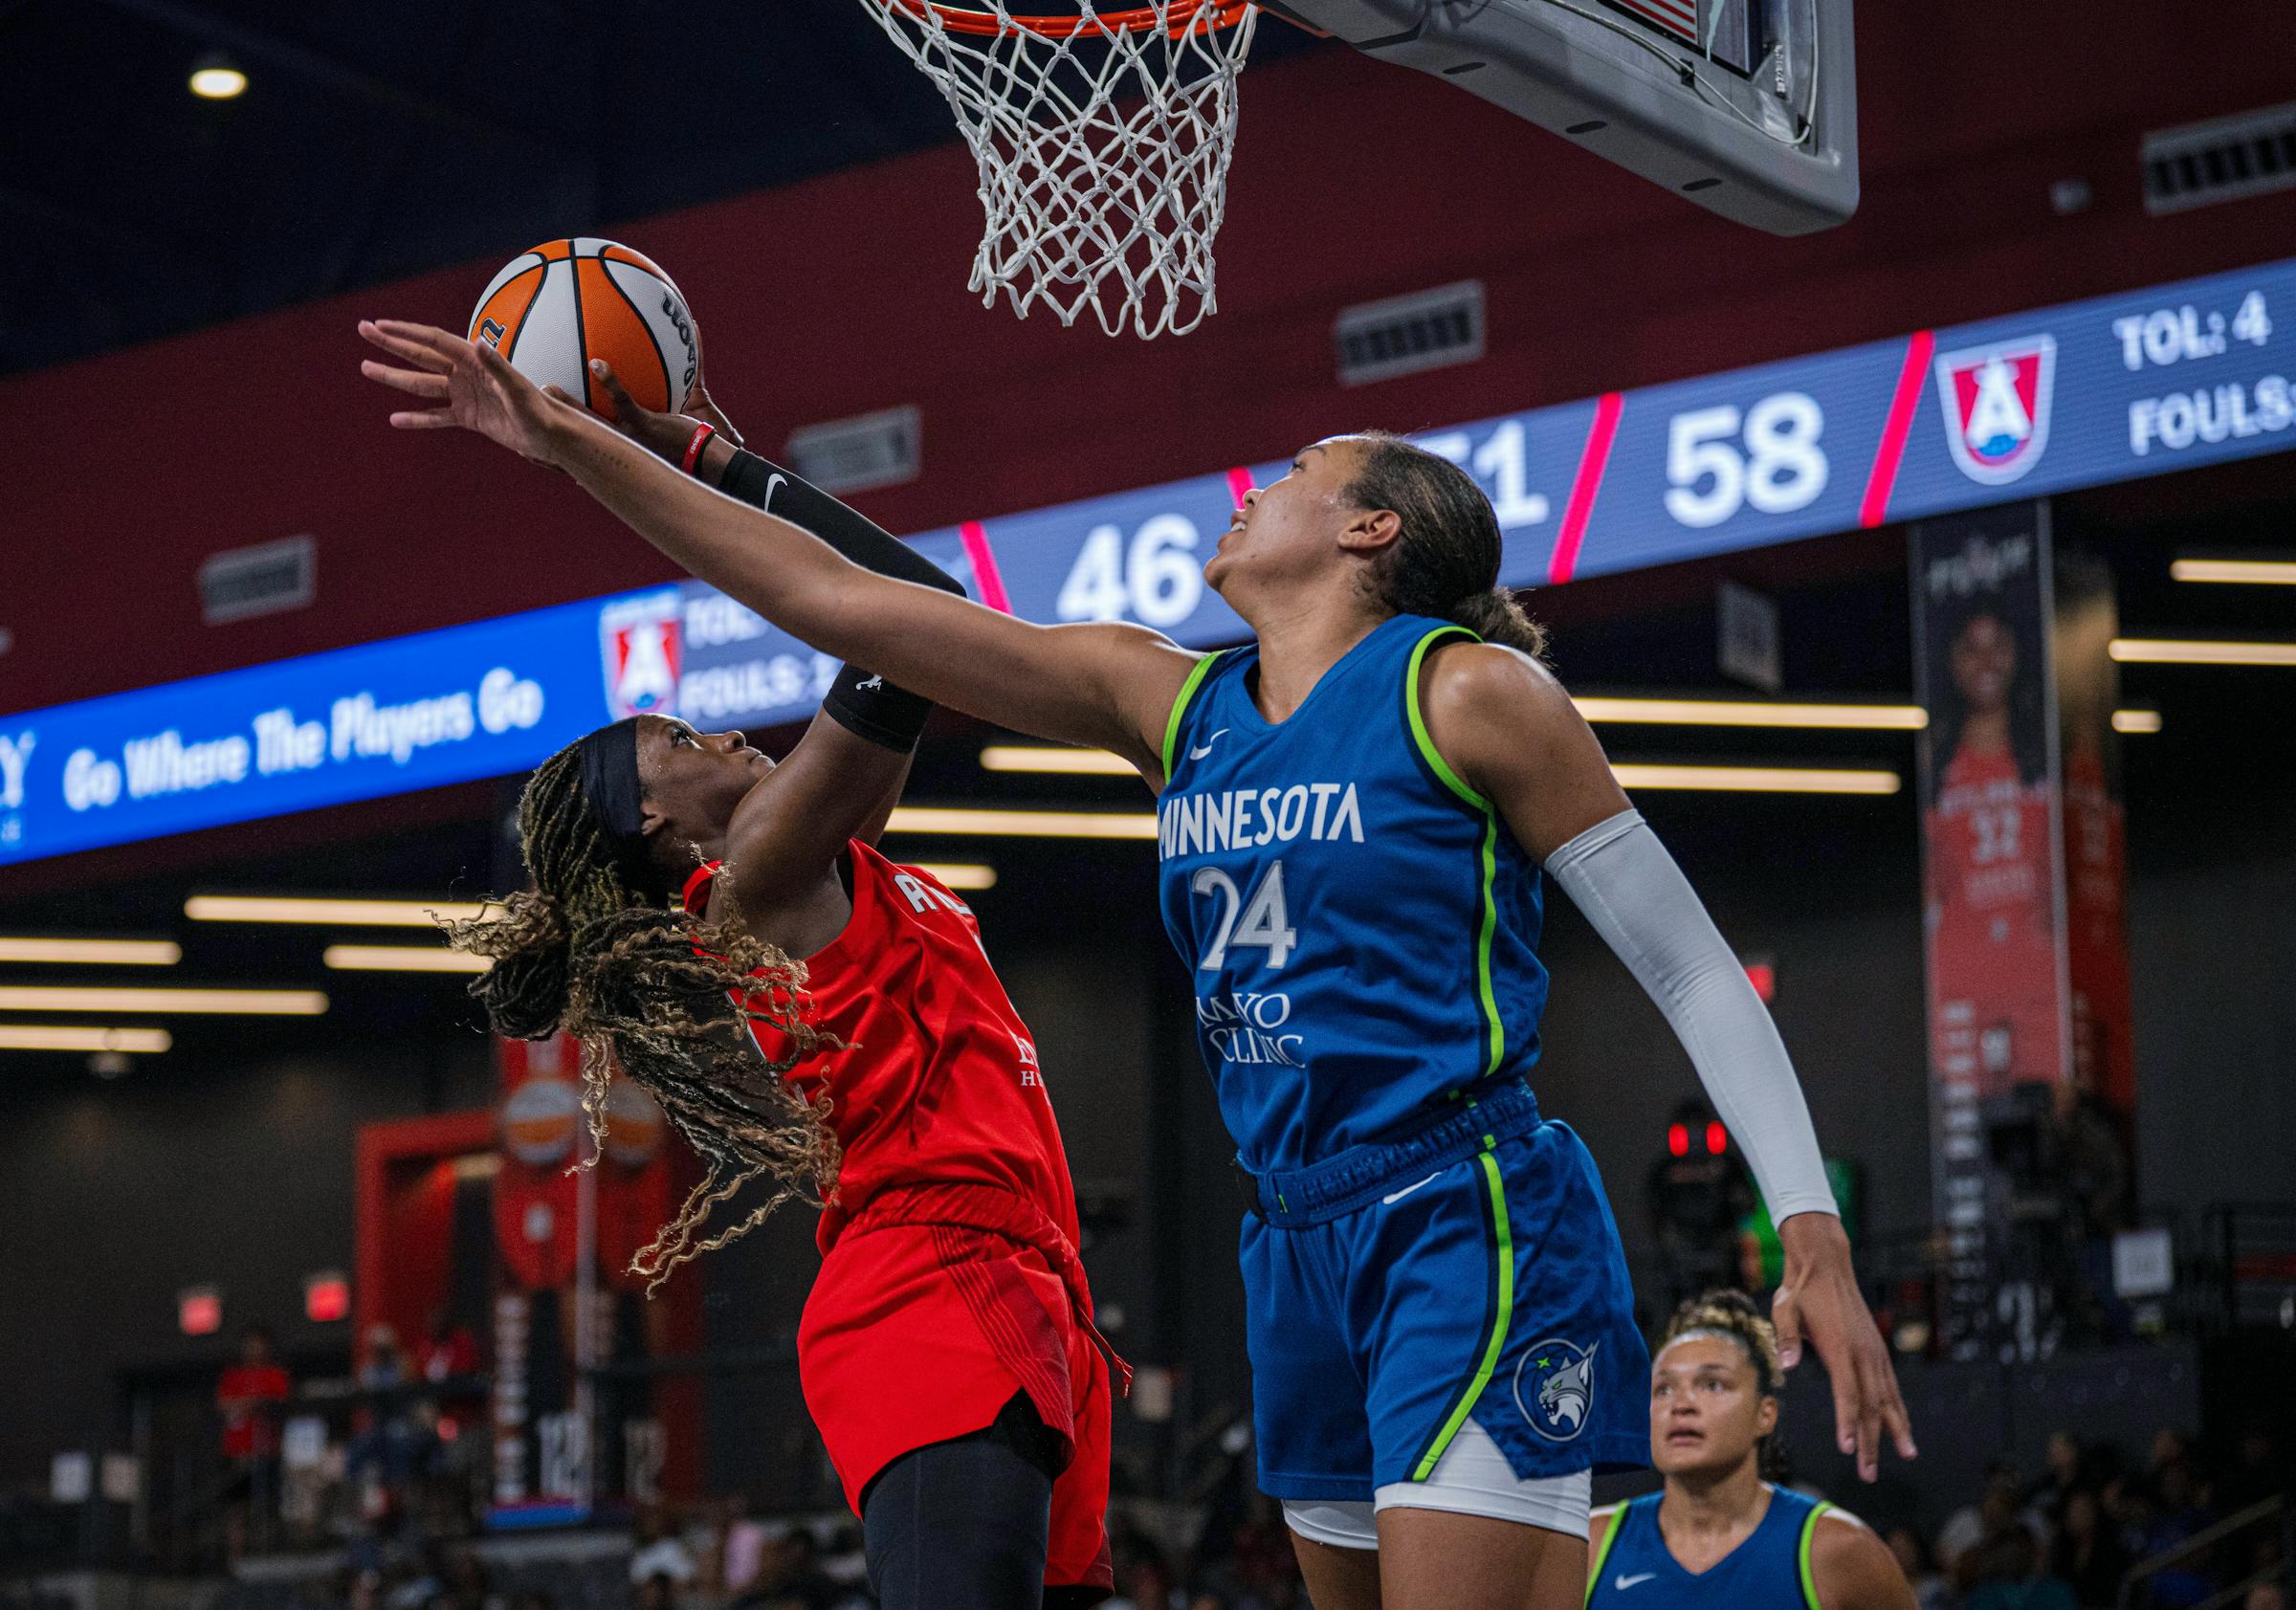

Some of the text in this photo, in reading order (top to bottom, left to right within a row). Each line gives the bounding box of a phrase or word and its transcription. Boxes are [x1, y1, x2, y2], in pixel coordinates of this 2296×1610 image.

[2112, 291, 2272, 371] TOL: 4
[1408, 419, 1550, 530] 1
[1665, 392, 1828, 528] 58
[1057, 515, 1203, 628] 46
[63, 667, 544, 811] Go Where The Players Go
[1158, 783, 1365, 862] MINNESOTA
[1192, 860, 1297, 972] 24
[1196, 993, 1291, 1029] MYO
